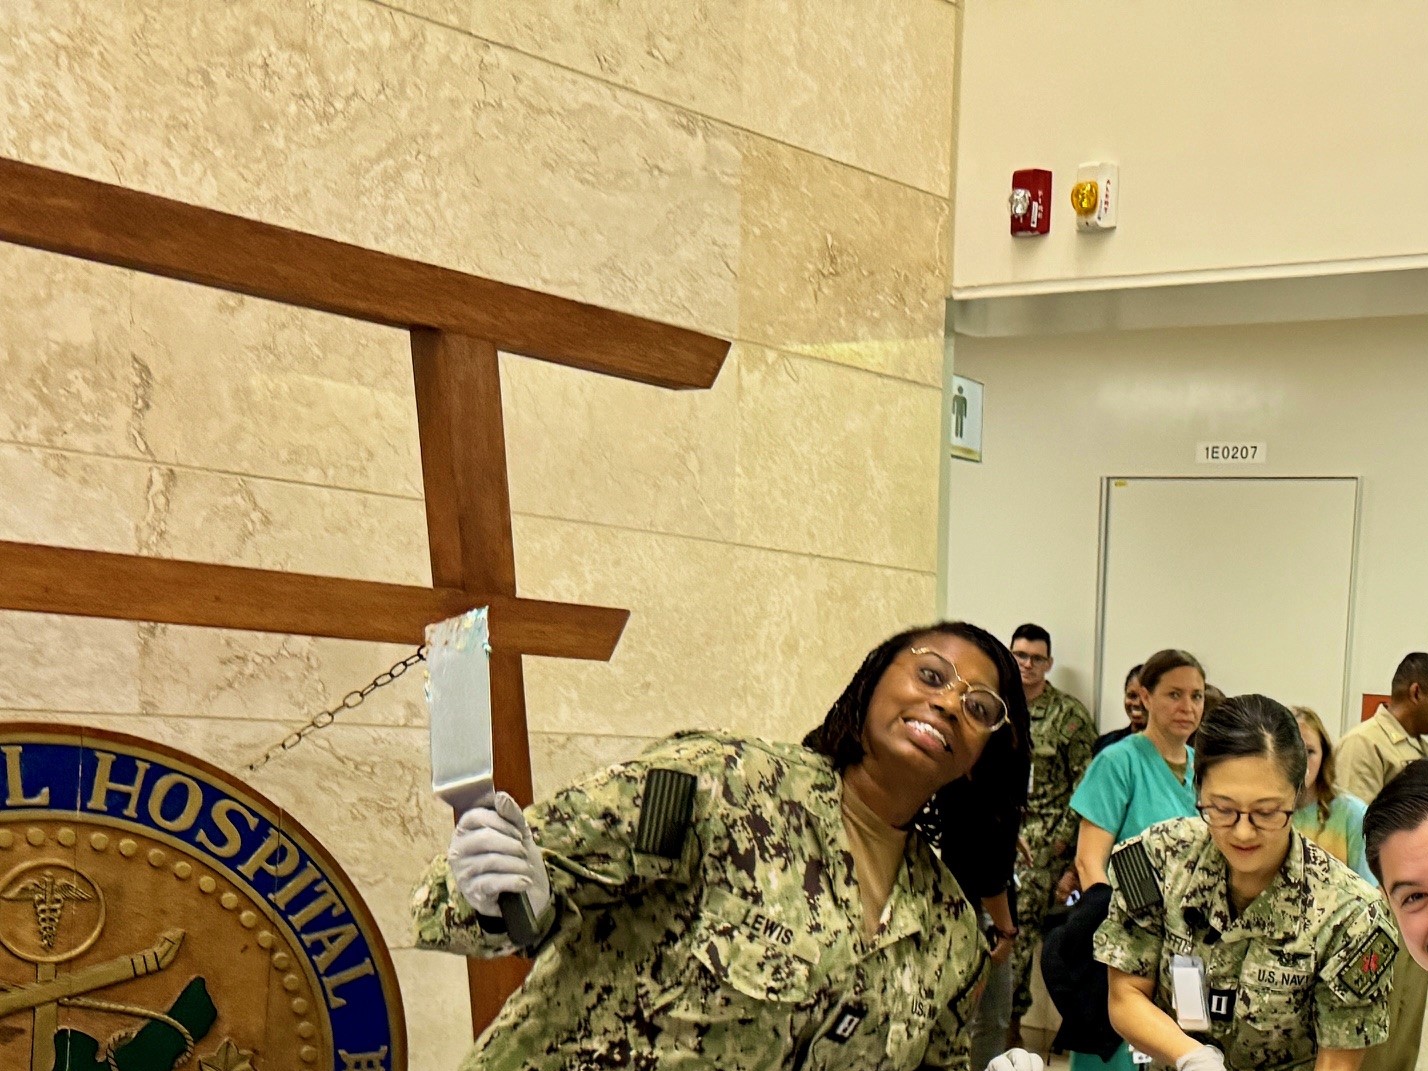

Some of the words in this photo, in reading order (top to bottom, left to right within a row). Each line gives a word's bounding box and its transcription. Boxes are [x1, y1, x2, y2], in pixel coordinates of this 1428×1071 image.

[1205, 445, 1258, 459] 1E0207
[86, 750, 376, 1009] HOSPITAL
[741, 908, 794, 945] LEWIS
[1257, 969, 1278, 986] U.S.
